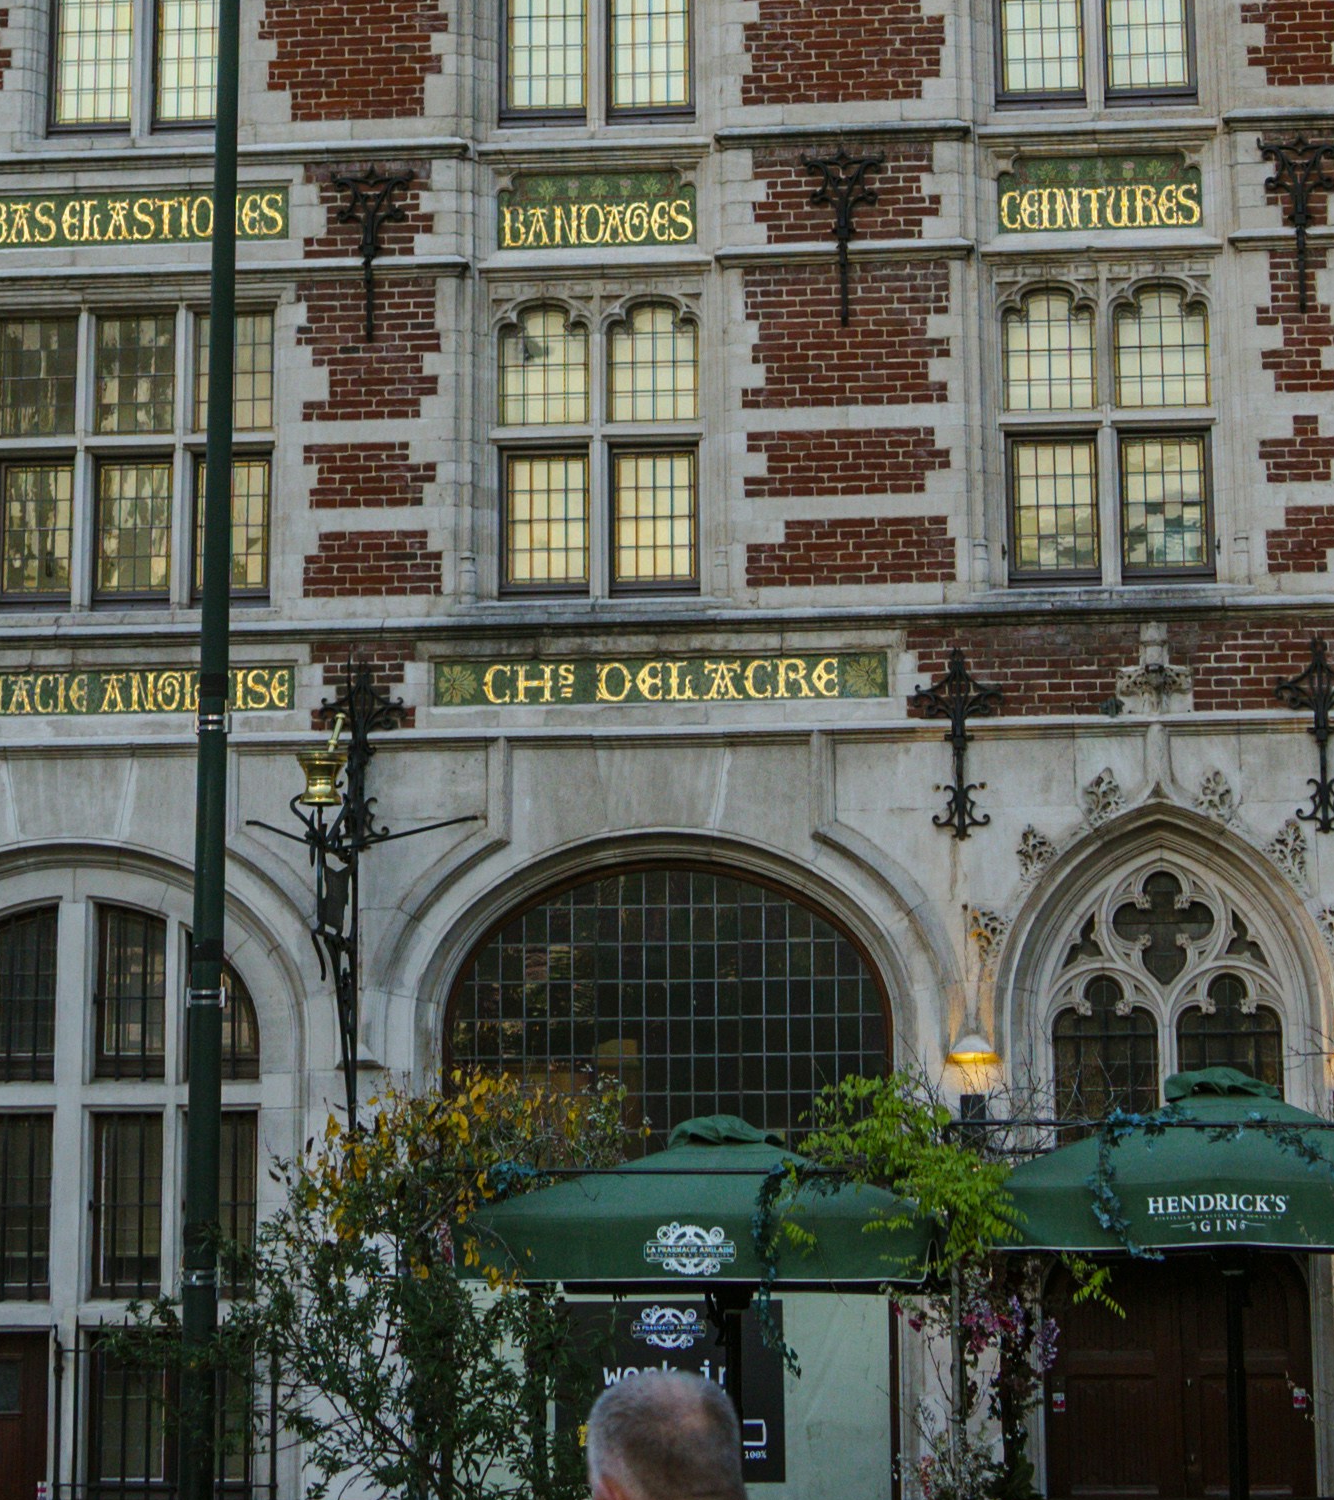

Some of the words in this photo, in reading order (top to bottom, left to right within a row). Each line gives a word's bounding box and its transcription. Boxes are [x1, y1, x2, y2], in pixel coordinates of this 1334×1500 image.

[500, 199, 694, 248] BANDAGES
[1000, 183, 1202, 231] CEINTURES
[97, 669, 289, 714] ANGLISE
[595, 657, 840, 703] DELACRE
[1147, 1193, 1287, 1214] HENDRICK'S
[1200, 1219, 1238, 1232] GIN
[743, 1450, 768, 1460] 100%
